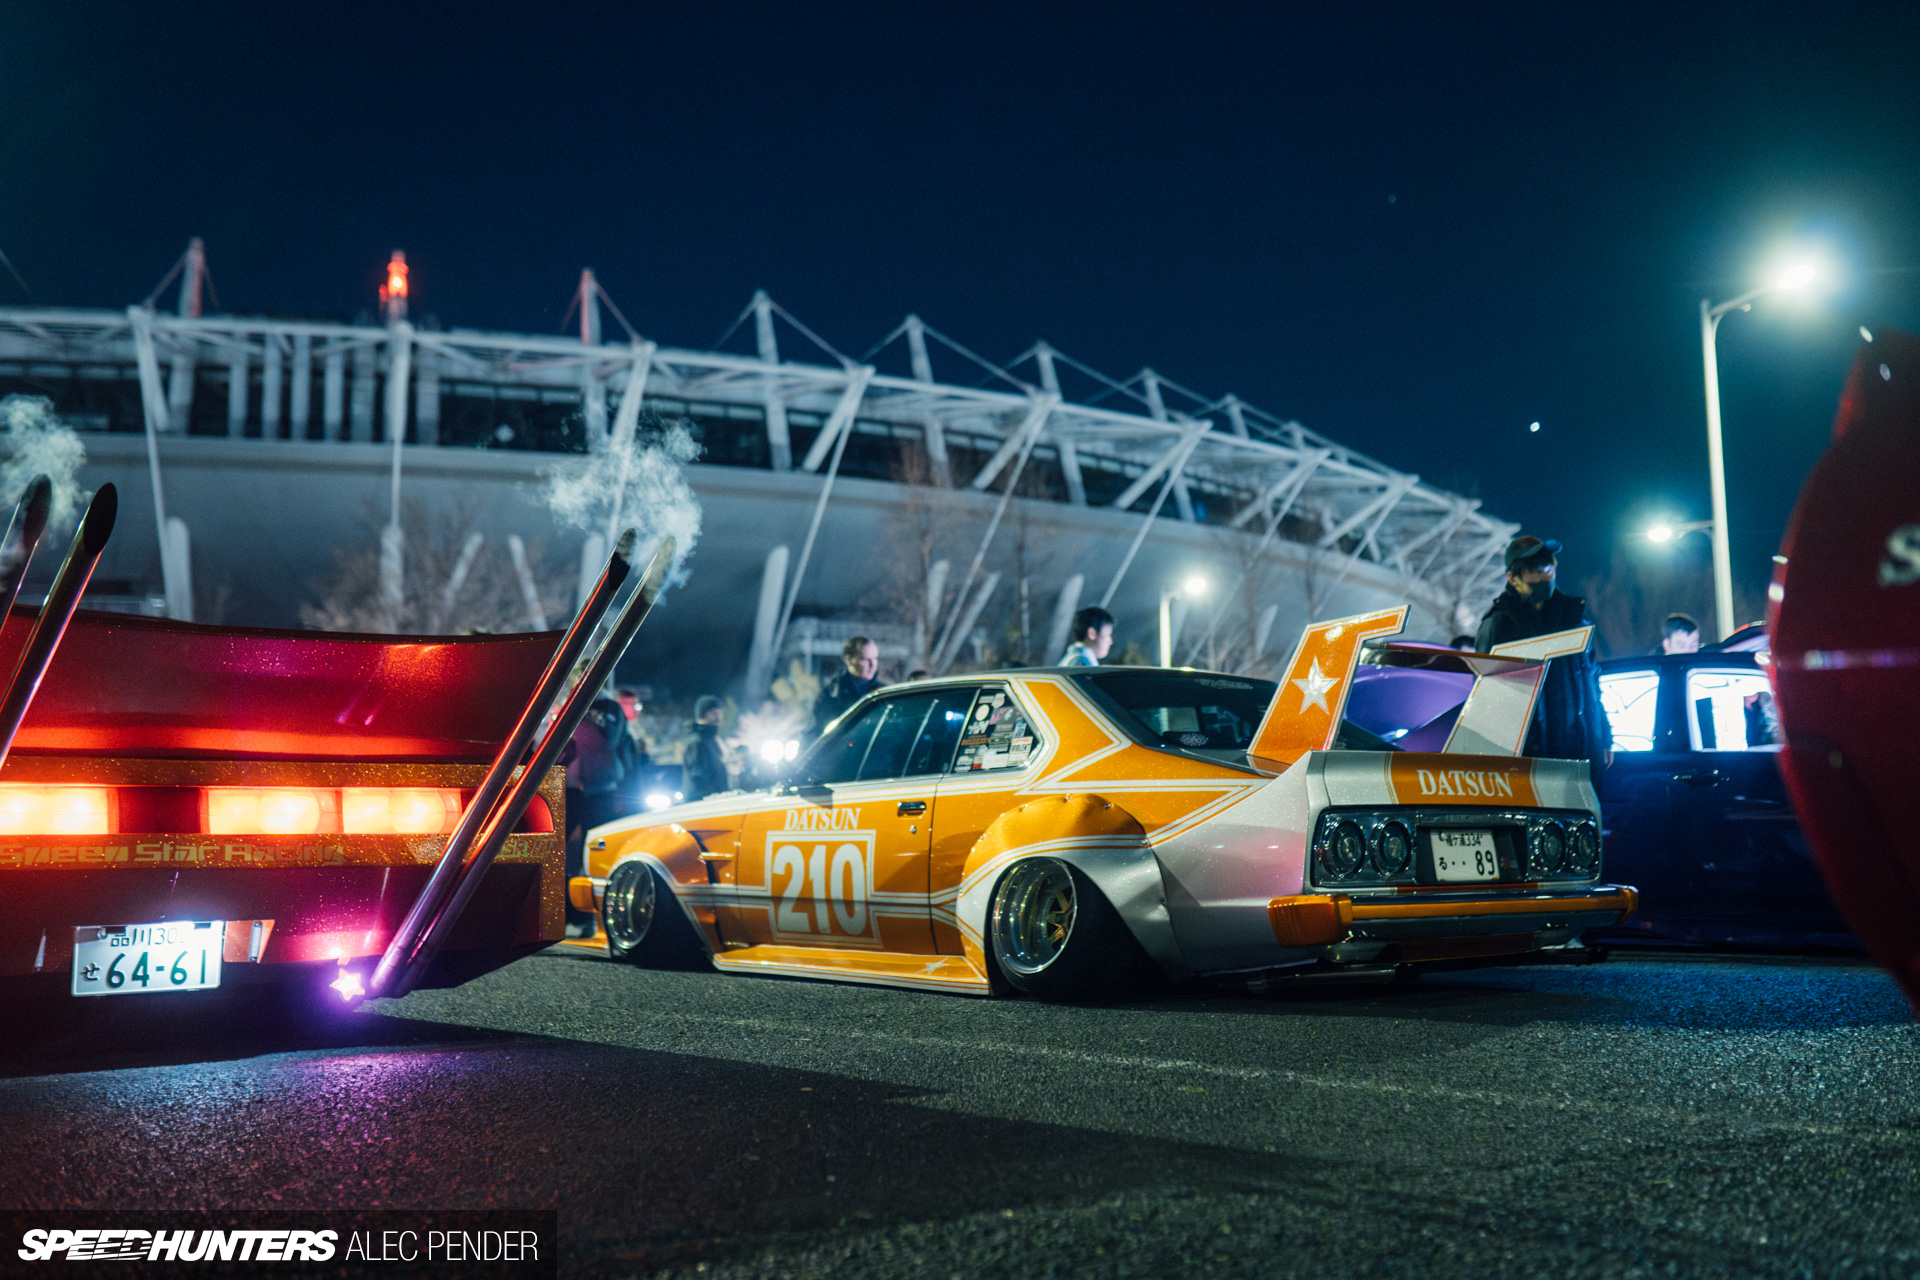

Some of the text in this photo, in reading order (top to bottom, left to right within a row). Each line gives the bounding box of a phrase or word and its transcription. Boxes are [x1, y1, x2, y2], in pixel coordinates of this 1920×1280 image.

[1417, 769, 1513, 797] DATSUN
[784, 807, 862, 831] DATSUN
[772, 843, 867, 935] 210
[80, 949, 208, 988] せ 64-61
